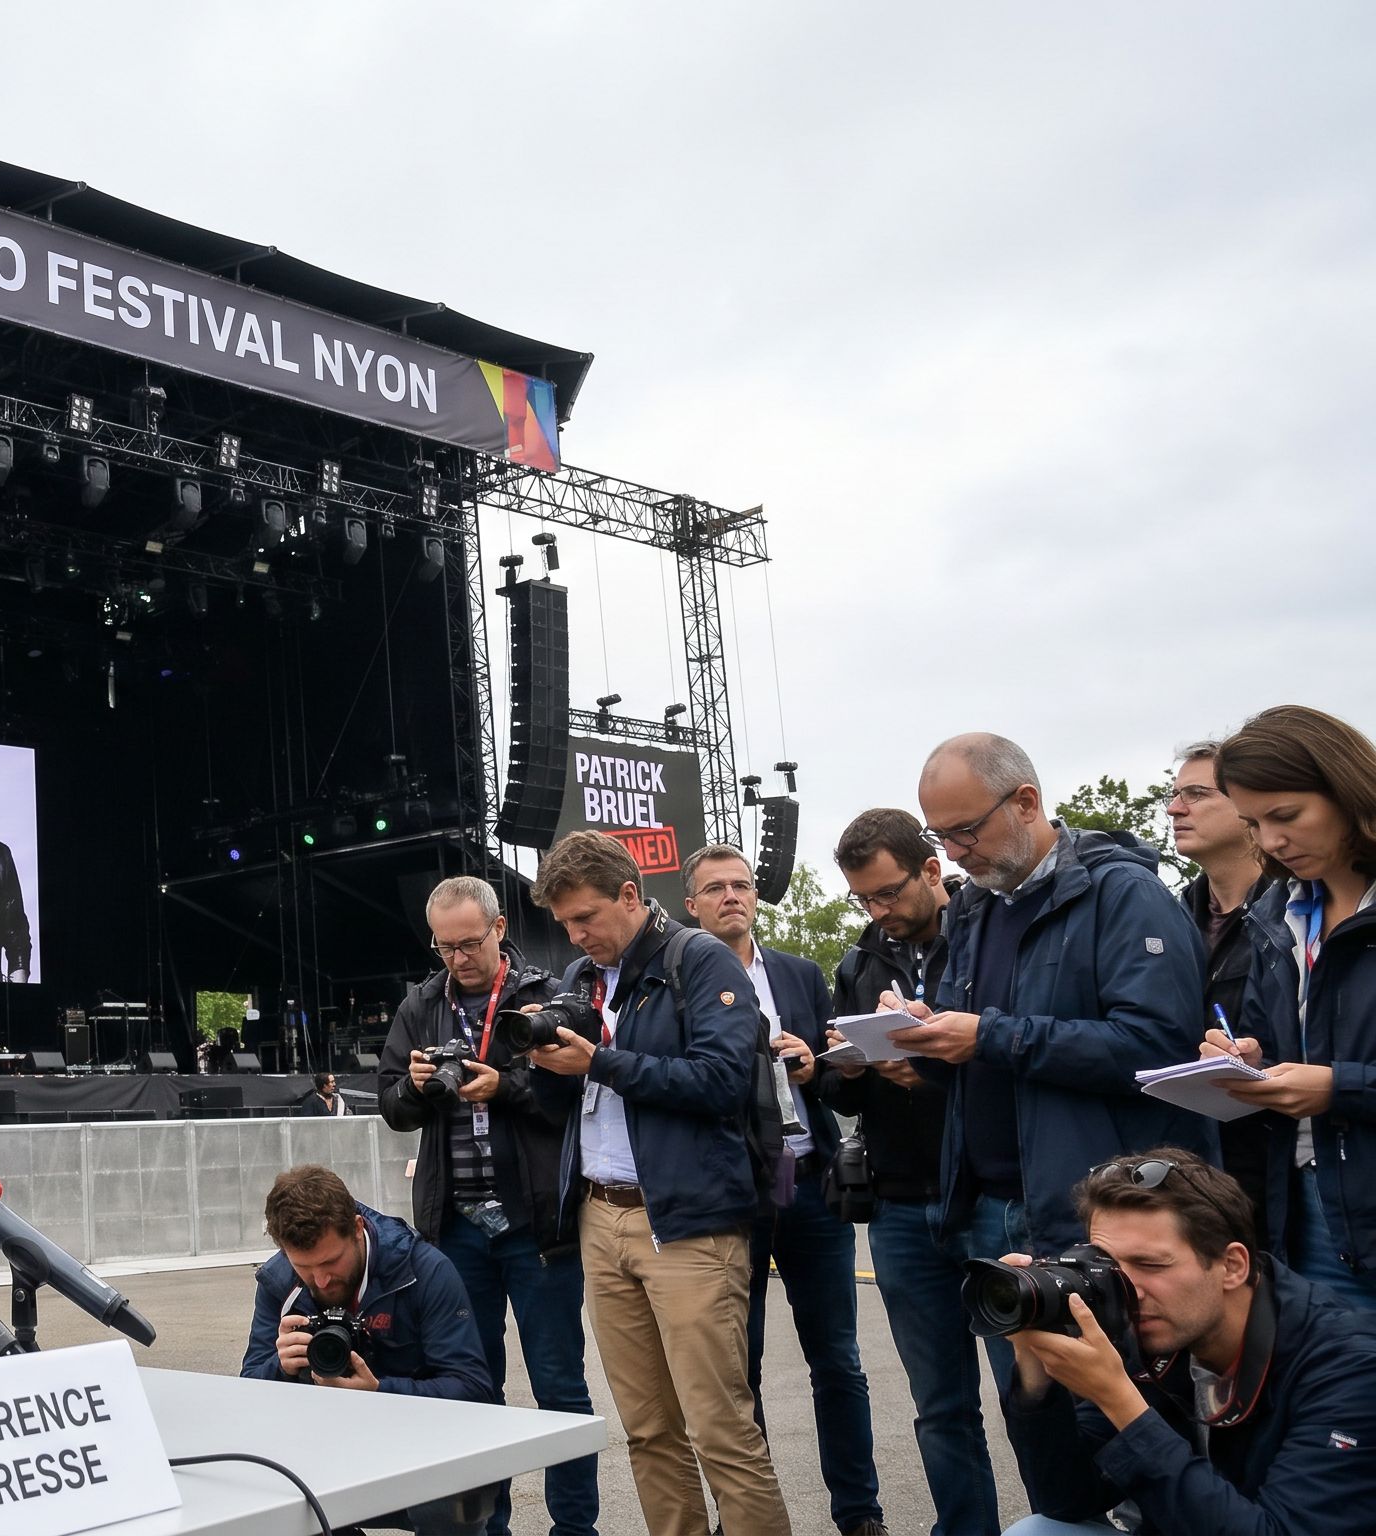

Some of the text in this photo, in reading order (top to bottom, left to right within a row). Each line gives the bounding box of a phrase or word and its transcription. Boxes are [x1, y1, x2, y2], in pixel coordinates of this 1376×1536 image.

[47, 251, 299, 374] FESTIVAL
[313, 333, 437, 414] NYON
[575, 752, 667, 793] PATRICK
[583, 787, 664, 829] BRUEL
[620, 834, 673, 867] NED
